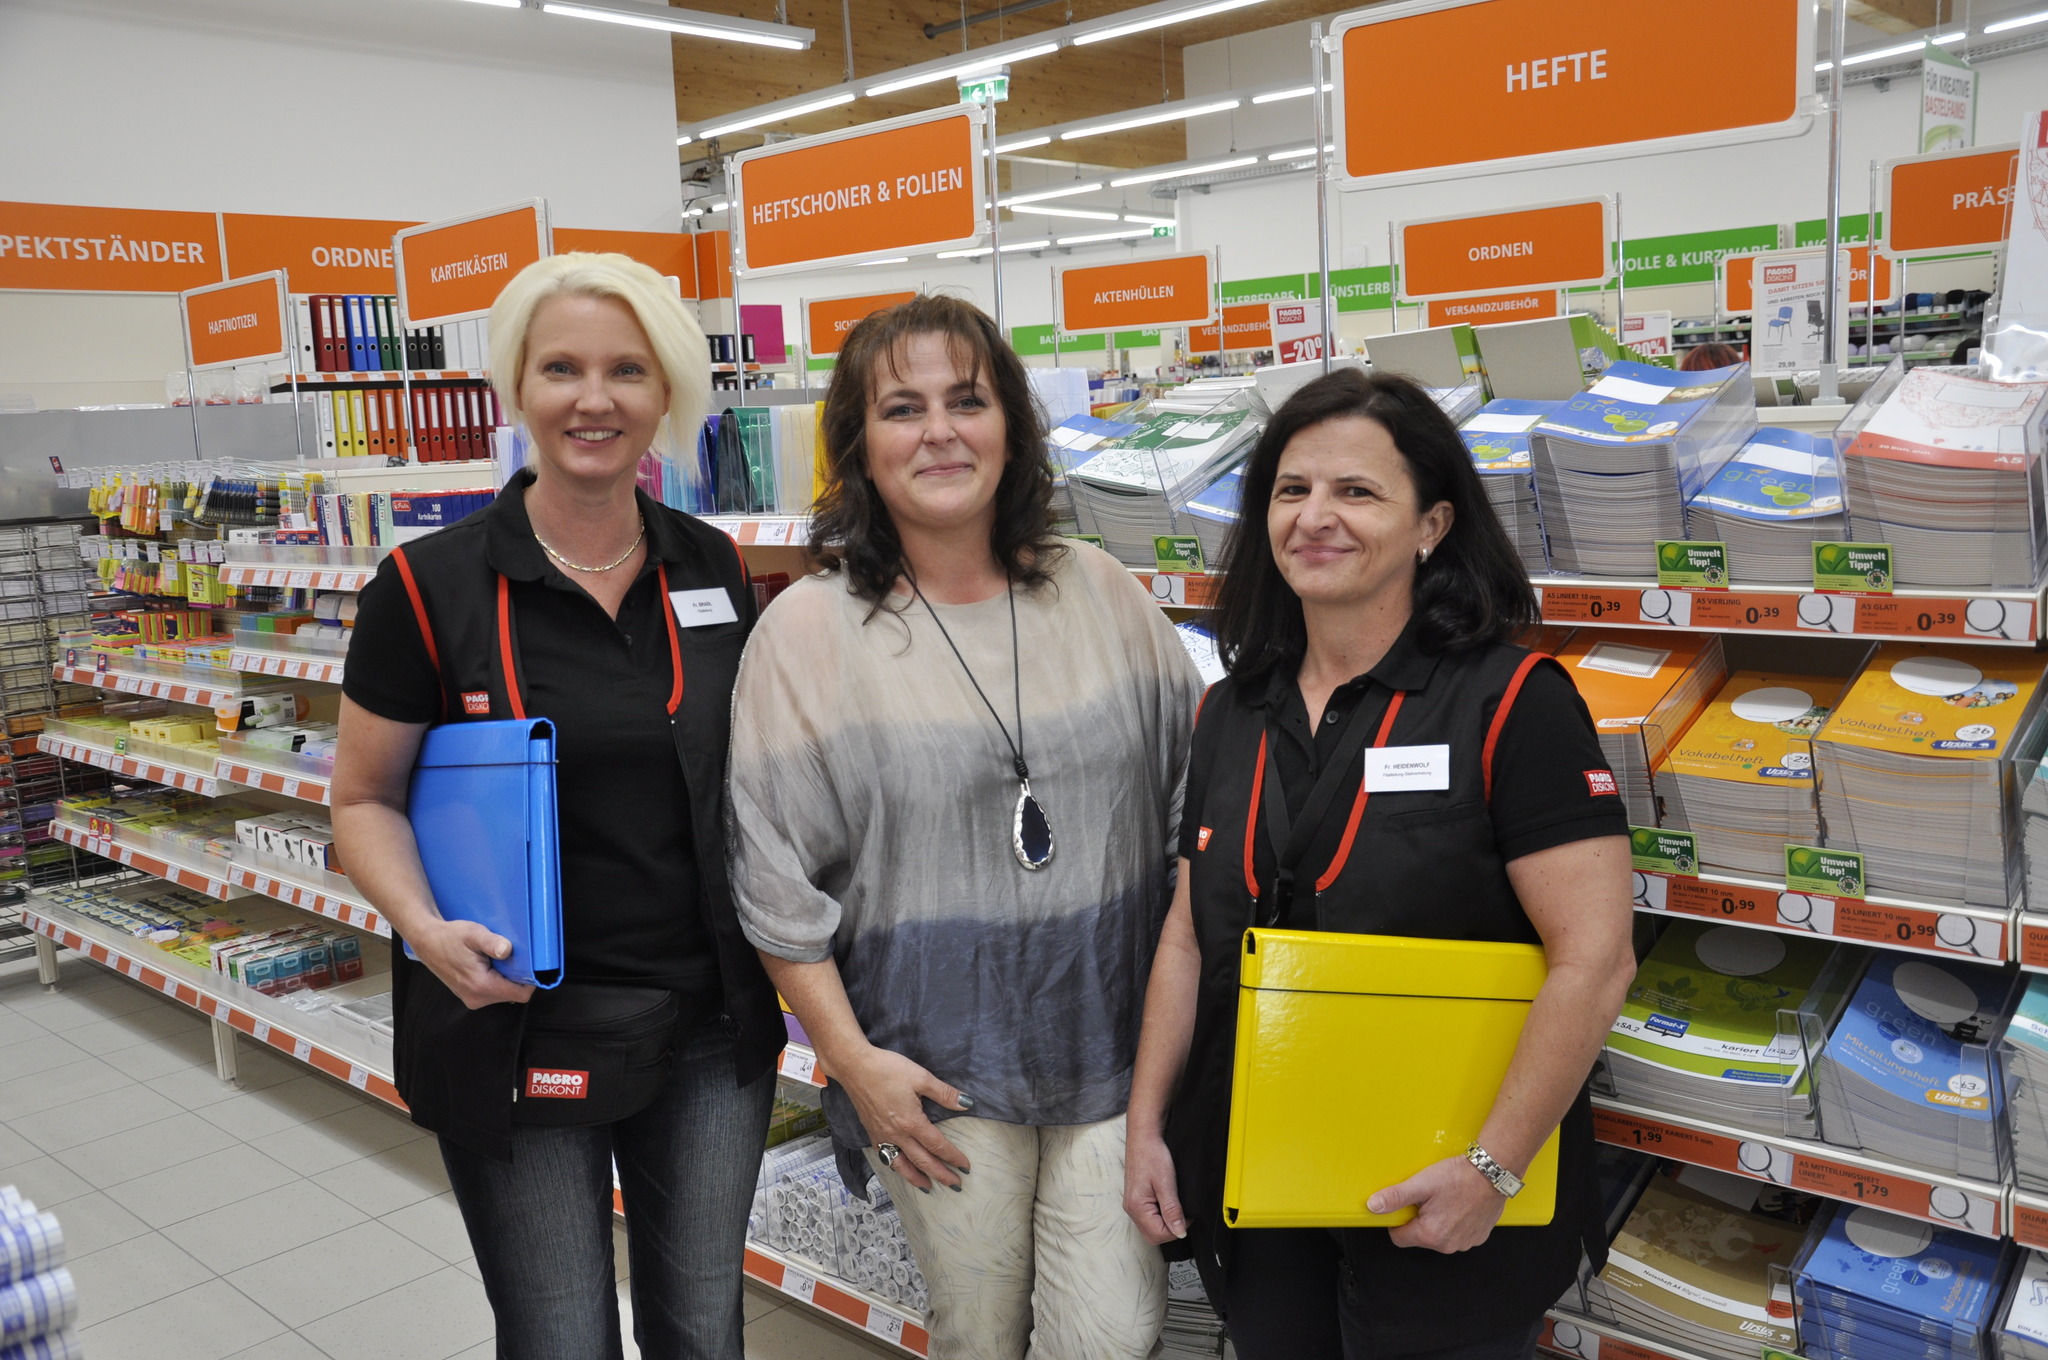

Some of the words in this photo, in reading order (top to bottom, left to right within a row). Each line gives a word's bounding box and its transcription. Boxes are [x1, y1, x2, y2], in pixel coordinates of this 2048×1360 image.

[1506, 50, 1607, 93] HEFTE
[1925, 69, 1939, 91] FÜR
[1940, 73, 1971, 99] KREATIVE
[752, 184, 872, 225] HEFTSCHONER
[877, 181, 891, 203] &
[896, 166, 963, 199] FOLIEN
[0, 234, 205, 264] PEKTSTÄNDER
[1468, 240, 1534, 262] ORDNEN
[1666, 254, 1678, 267] &
[430, 252, 509, 284] KARTEIKÄSTEN
[1767, 269, 1794, 277] PAGRO
[1094, 285, 1174, 304] AKTENHÜLLEN
[1768, 286, 1790, 295] DAMIT
[1792, 281, 1814, 290] SITZEN
[1781, 293, 1804, 302] ARBEITEN
[1445, 297, 1539, 317] VERSANDZUBEHÖR
[208, 313, 258, 335] HAFTNOTIZEN
[1569, 400, 1655, 420] green
[1722, 470, 1814, 491] green
[432, 504, 441, 512] 100
[1176, 549, 1190, 557] Tipp!
[1687, 549, 1721, 558] Umwelt
[1848, 551, 1886, 561] Umwelt
[1689, 558, 1710, 568] Tipp!
[1849, 561, 1873, 571] Tipp!
[1591, 601, 1621, 618] 0,39
[1746, 607, 1779, 624] 0,39
[1917, 613, 1956, 631] 0,39
[1839, 717, 1936, 739] Vokabelheft
[1680, 749, 1764, 764] Vokabelheft
[1658, 837, 1691, 847] Umwelt
[1659, 845, 1680, 855] Tipp!
[1820, 857, 1857, 868] Umwelt
[1821, 865, 1845, 876] Tipp!
[1684, 885, 1708, 893] LINIERT
[1721, 898, 1755, 915] 0,99
[1853, 910, 1881, 918] LINIERT
[1896, 923, 1934, 941] 0,99
[1650, 1016, 1686, 1030] Format-X
[1721, 1043, 1760, 1054] kariert
[1844, 1033, 1940, 1087] Mitteilungsheft
[532, 1072, 583, 1085] PAGRO
[531, 1084, 581, 1095] DISKONT
[1665, 1129, 1693, 1139] KARIERT
[1799, 1169, 1825, 1180] LINIERT
[1810, 1163, 1879, 1184] MITTEILUNGSHEFT
[1882, 1258, 1907, 1296] green
